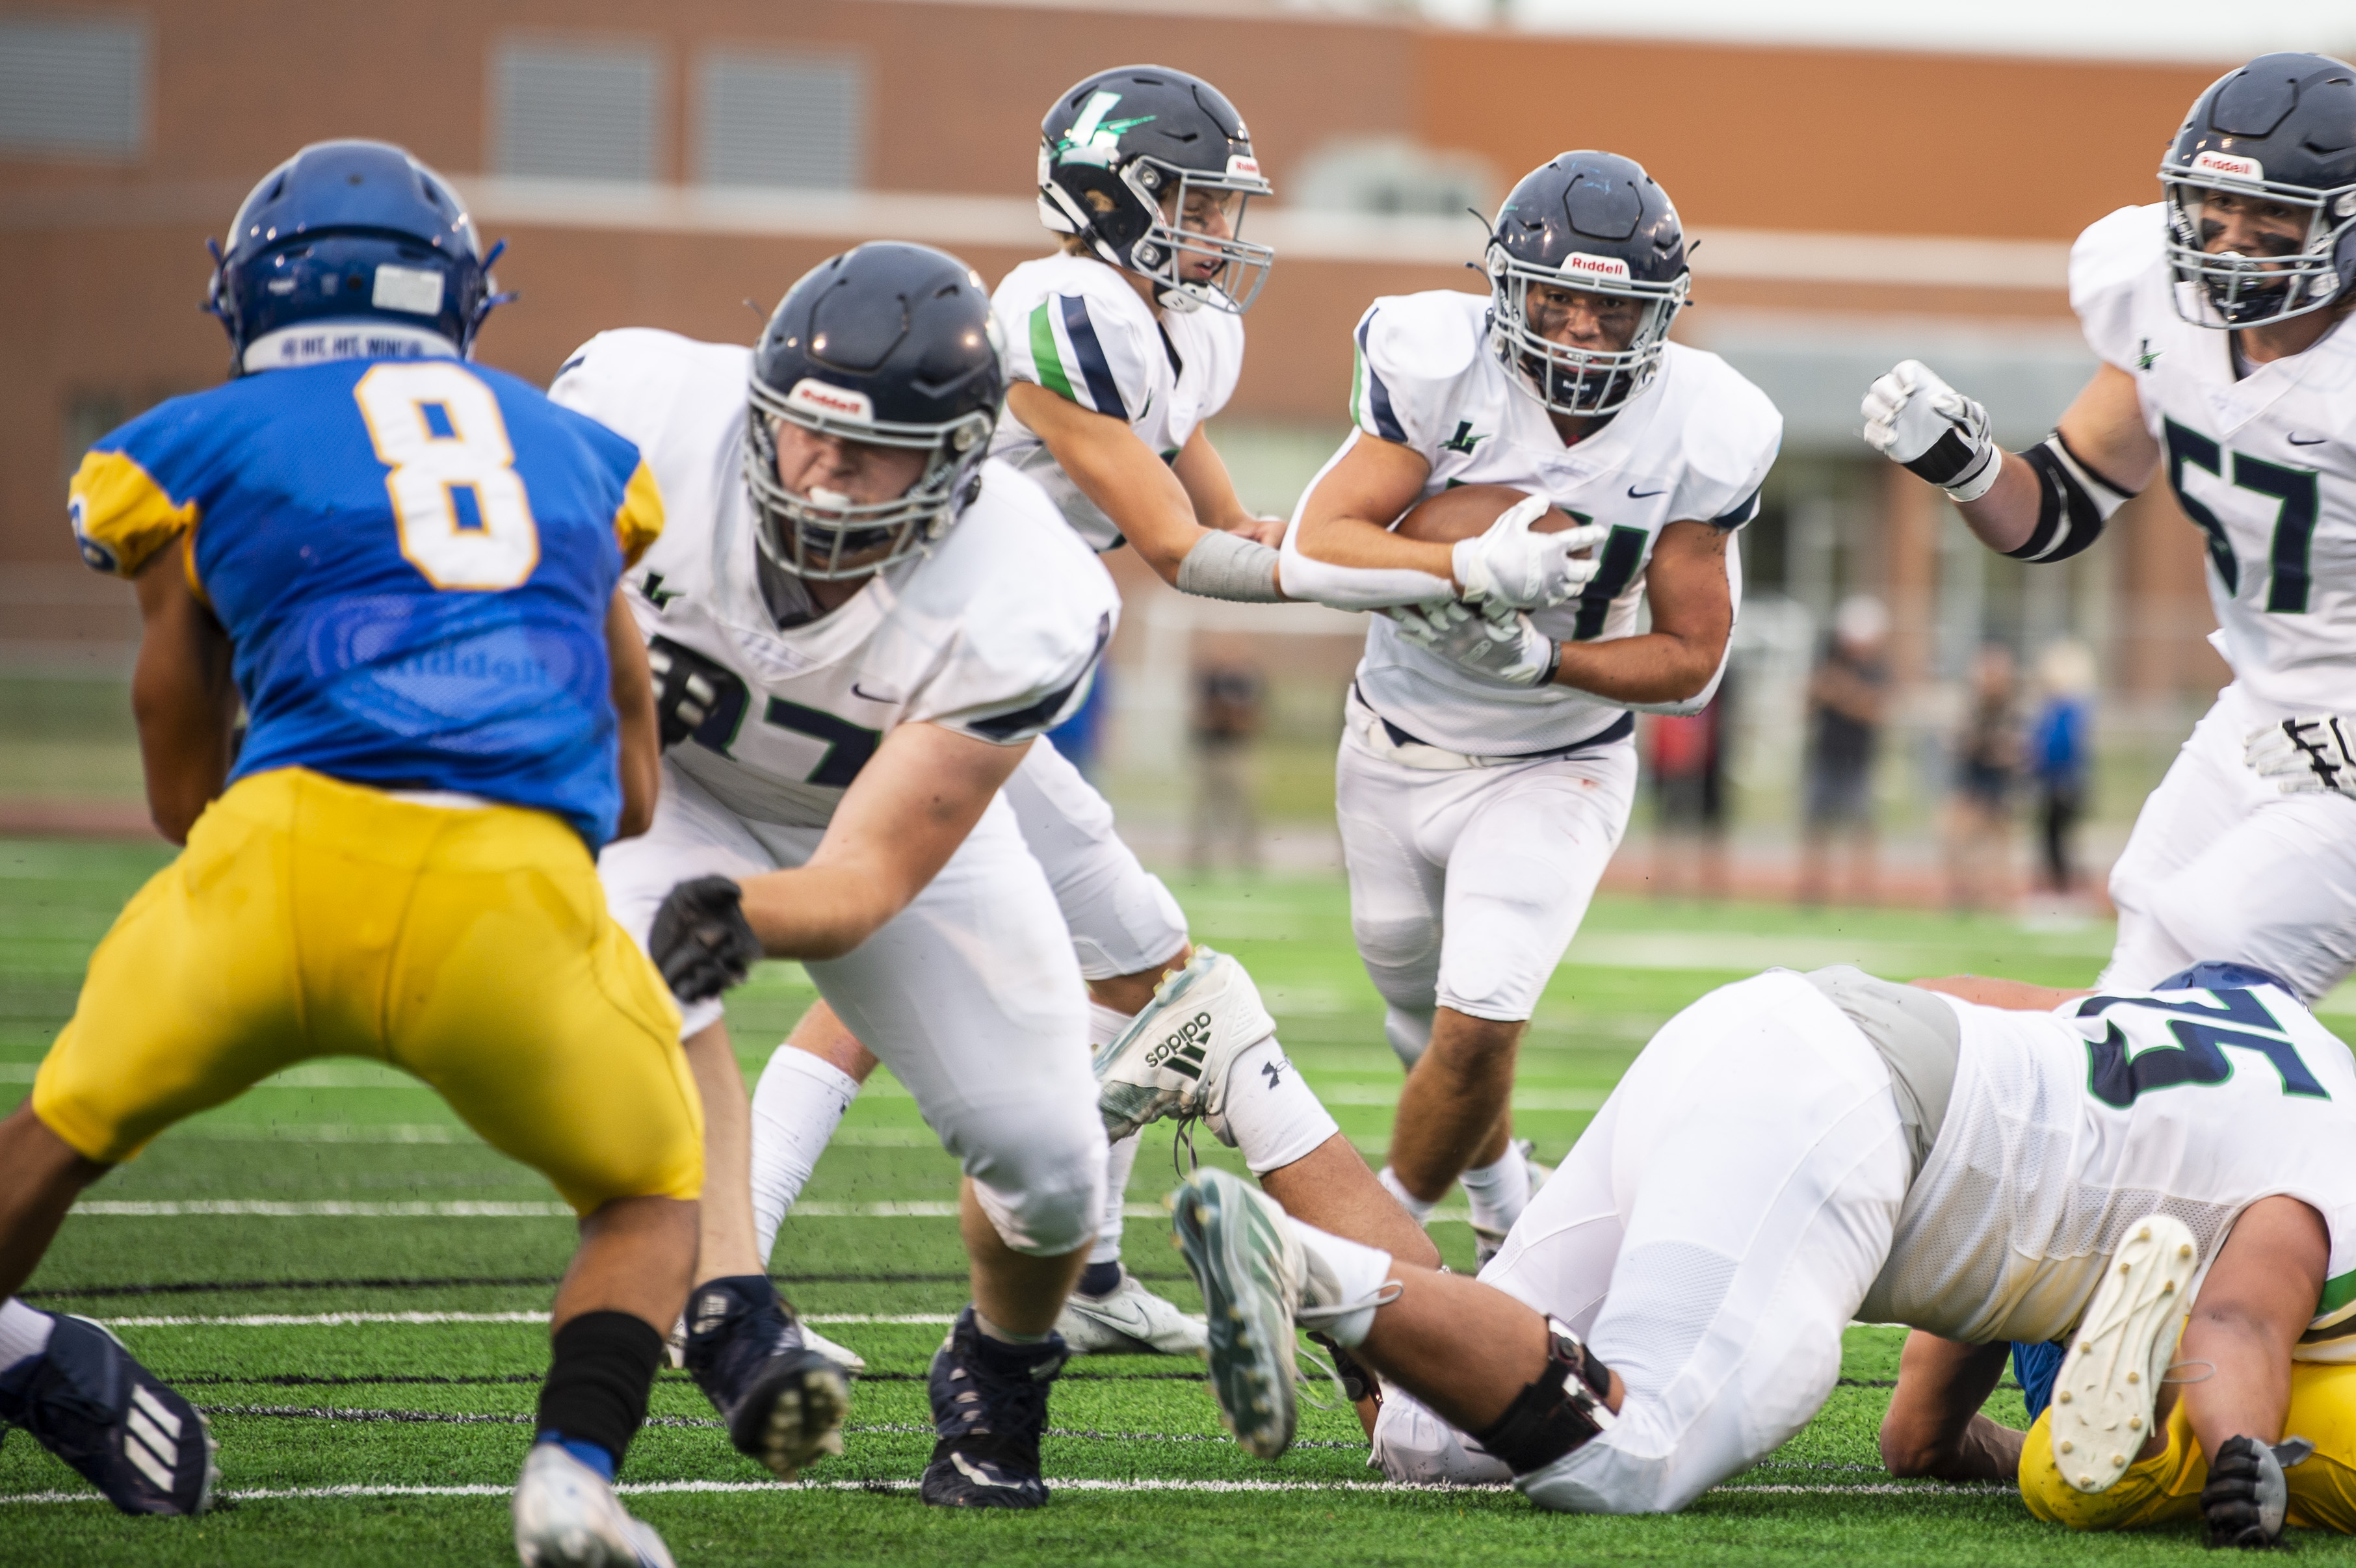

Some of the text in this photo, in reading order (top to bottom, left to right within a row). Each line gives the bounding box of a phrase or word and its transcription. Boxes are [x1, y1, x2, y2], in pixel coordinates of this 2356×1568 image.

[2202, 157, 2252, 174] Riddell
[1572, 257, 1623, 274] Riddell
[802, 389, 860, 413] Riddell
[354, 361, 542, 592] 8
[2164, 415, 2318, 614] 57
[1145, 1012, 1211, 1067] adidas
